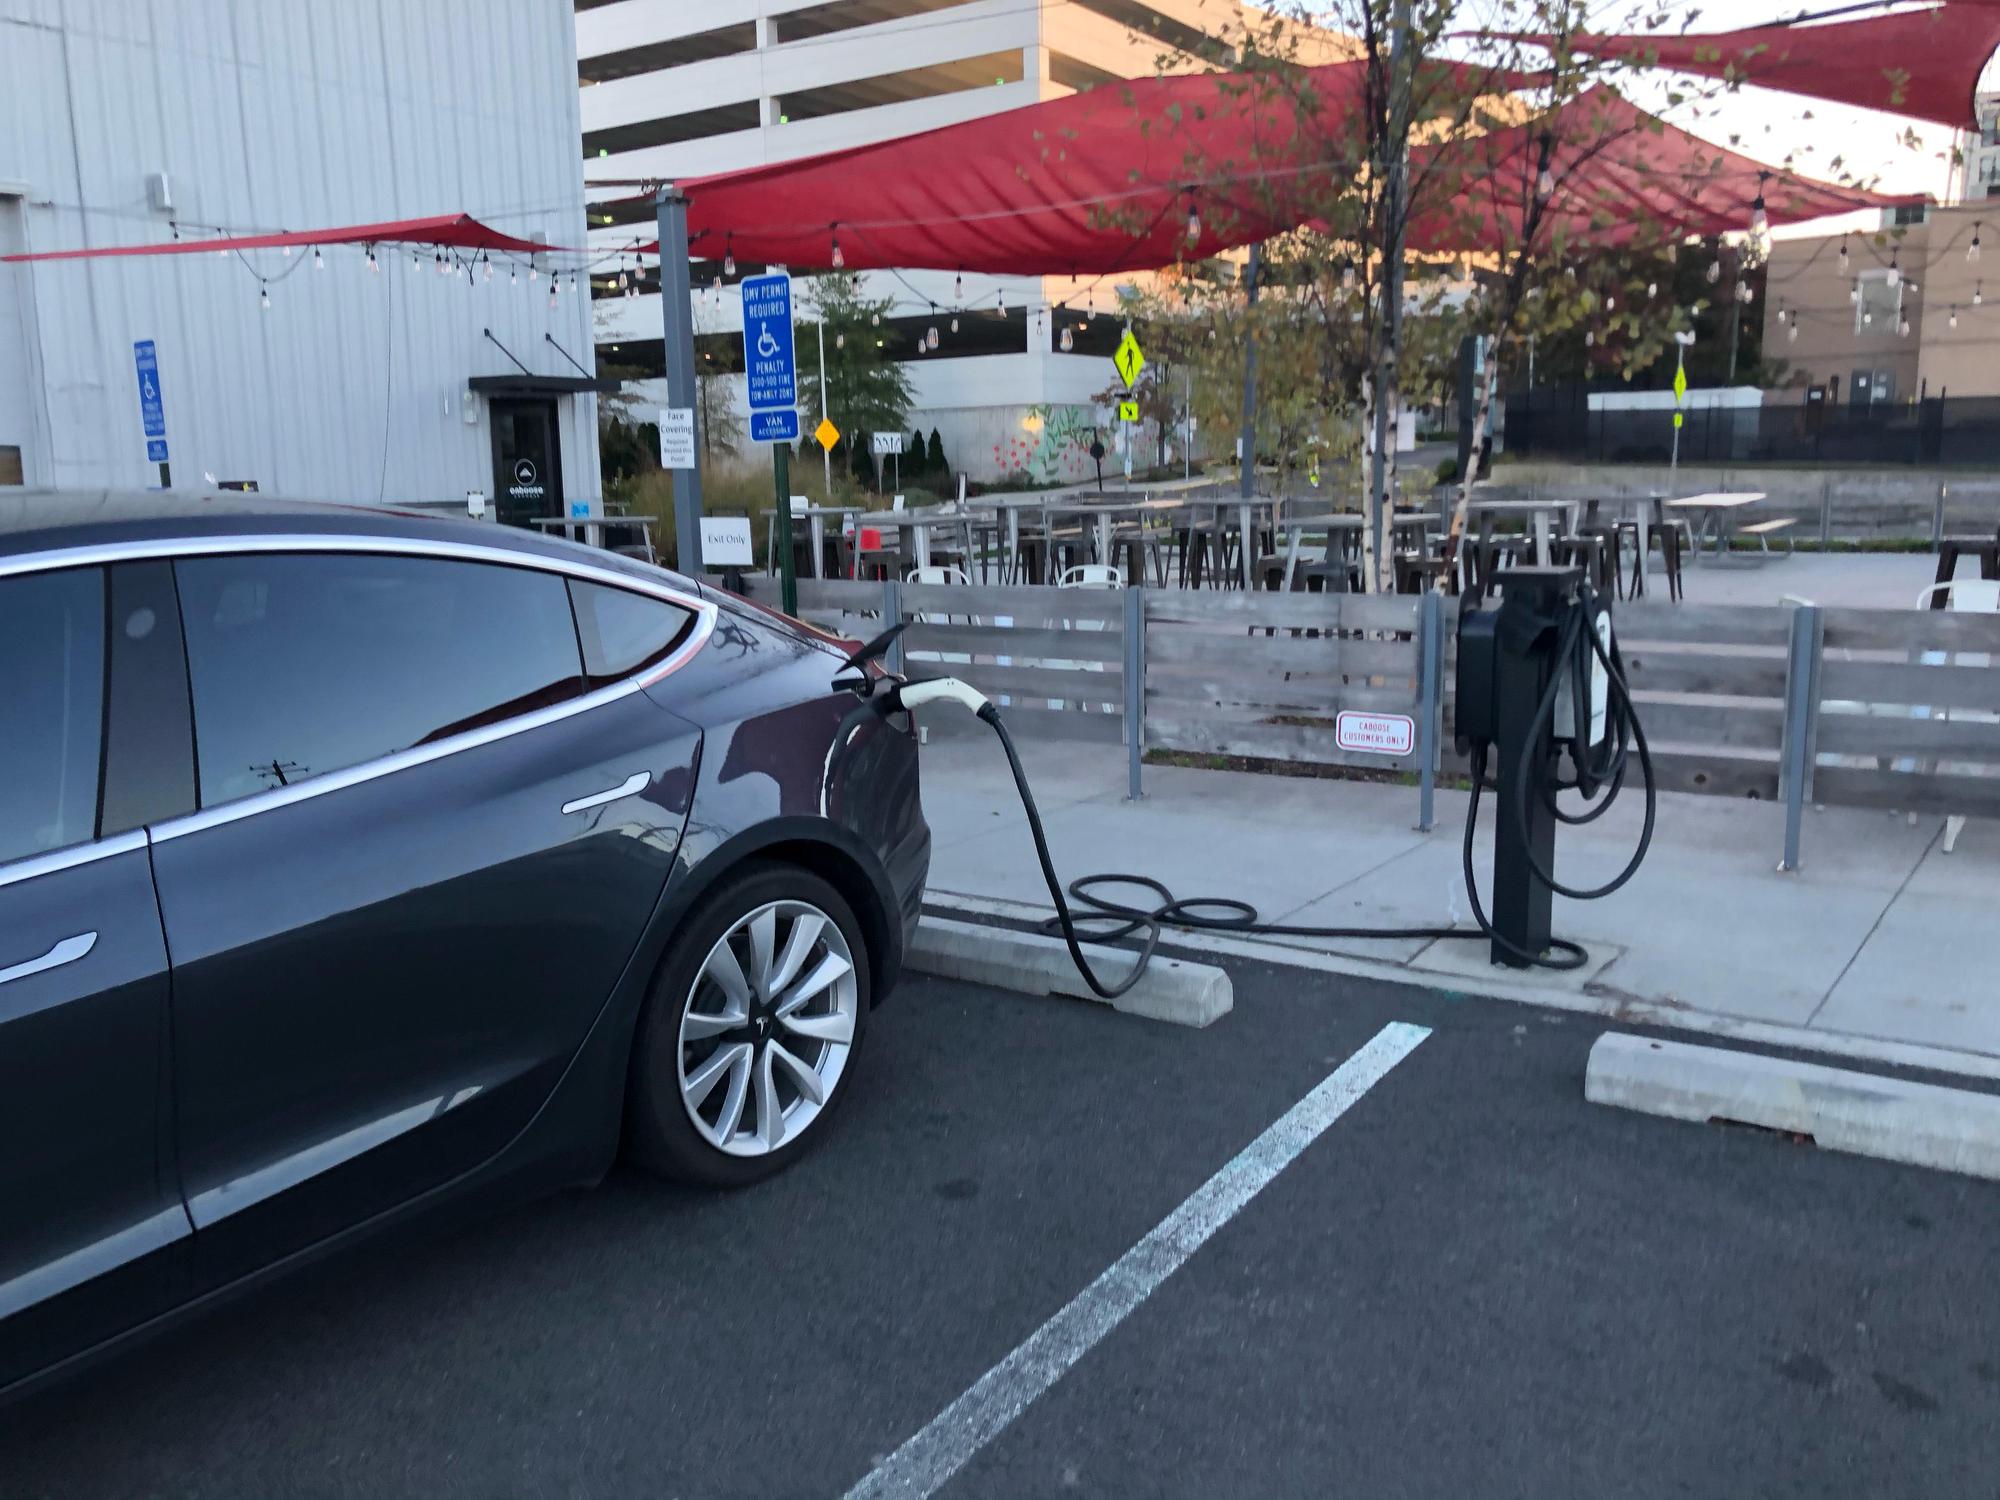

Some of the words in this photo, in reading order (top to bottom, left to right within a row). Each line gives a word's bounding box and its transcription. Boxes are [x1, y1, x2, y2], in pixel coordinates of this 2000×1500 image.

[744, 286, 759, 303] DMV
[761, 282, 787, 300] PERMIT
[749, 301, 785, 319] REQUIRED
[755, 360, 784, 375] PENALTY
[765, 415, 783, 427] VAN
[660, 424, 692, 435] Covering
[708, 535, 724, 545] Exit
[726, 535, 746, 546] Only
[1359, 722, 1390, 733] CABOOSE
[1344, 732, 1384, 744] CUSTOMERS
[1386, 736, 1405, 746] ONLY
